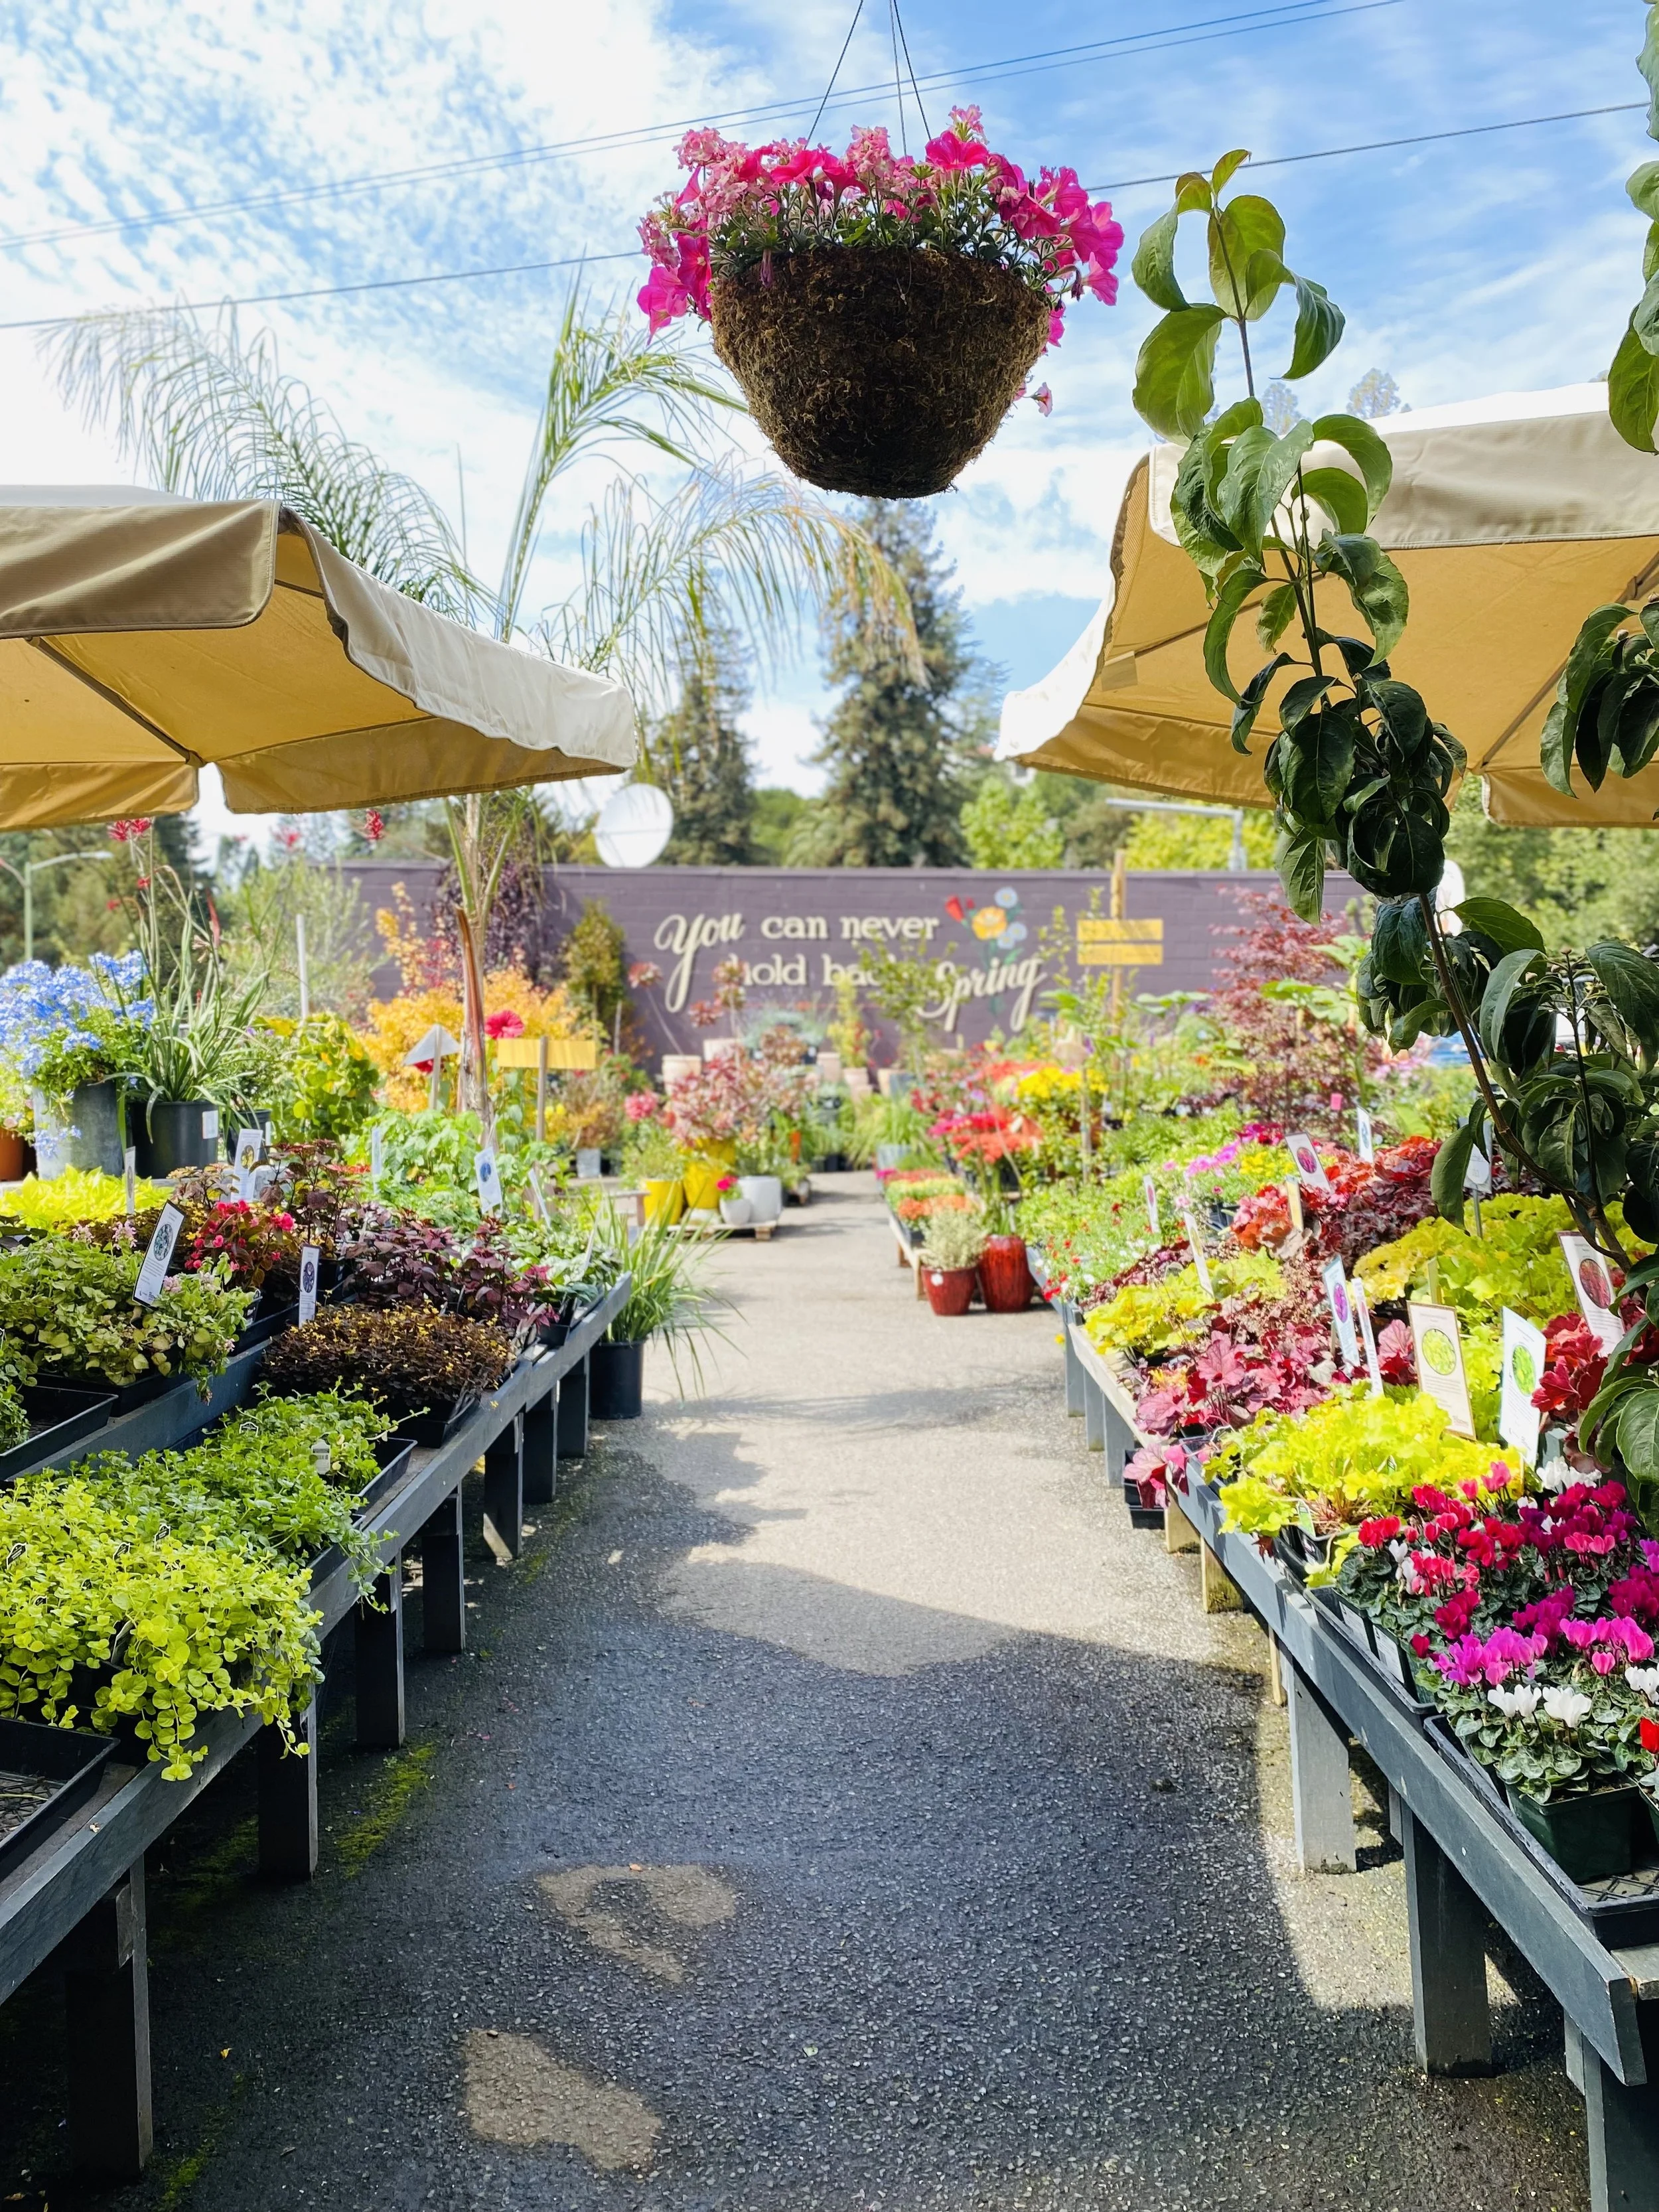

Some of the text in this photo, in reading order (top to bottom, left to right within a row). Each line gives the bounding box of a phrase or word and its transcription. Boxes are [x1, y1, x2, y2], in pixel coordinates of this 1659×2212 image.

[654, 912, 940, 1013] You can never
[821, 953, 904, 986] bac
[915, 957, 1048, 1032] Spring
